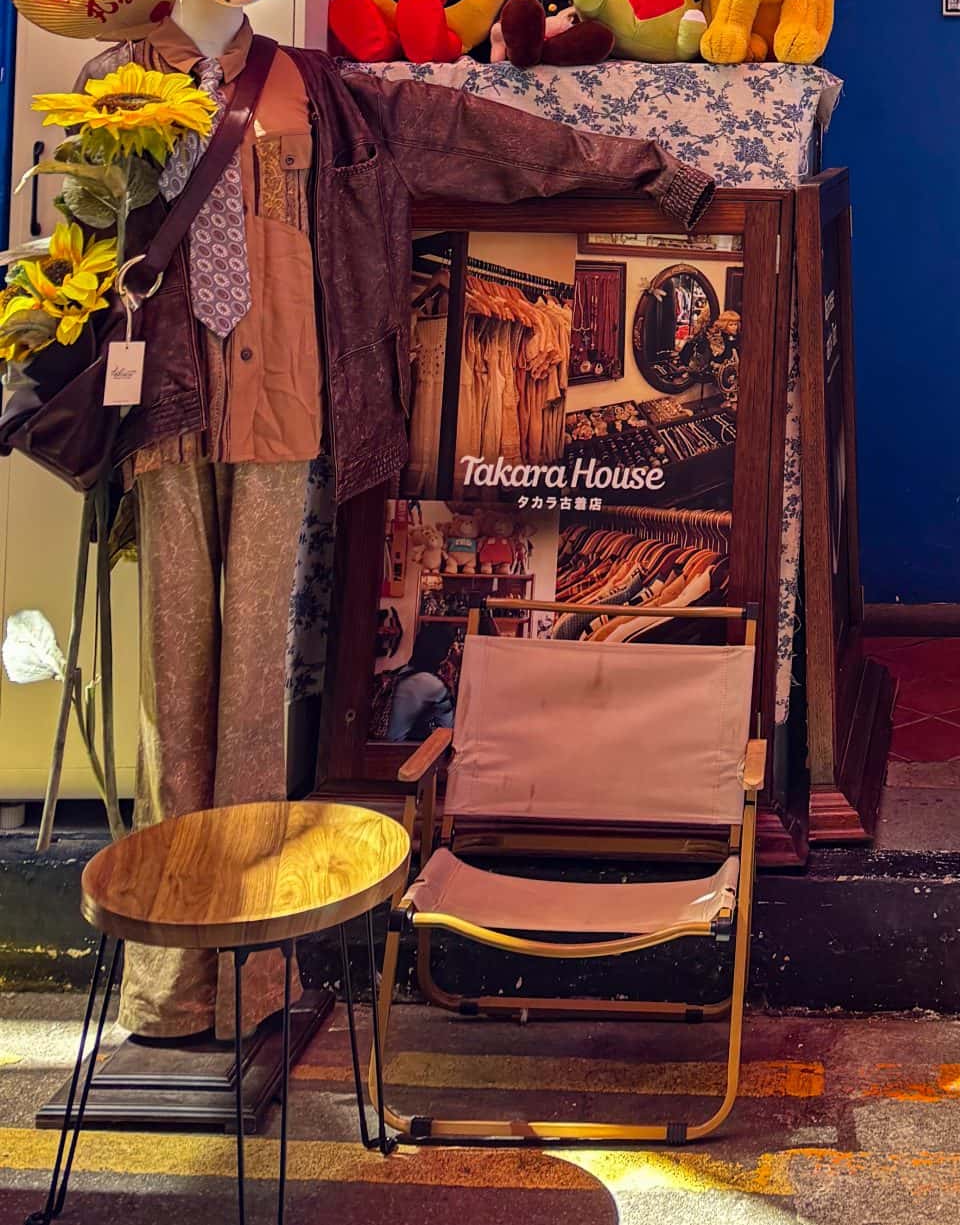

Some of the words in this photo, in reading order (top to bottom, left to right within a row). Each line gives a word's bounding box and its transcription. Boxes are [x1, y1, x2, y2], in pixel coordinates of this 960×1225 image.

[460, 455, 567, 488] Takara
[571, 457, 665, 490] House
[517, 495, 602, 510] タカラ古着店
